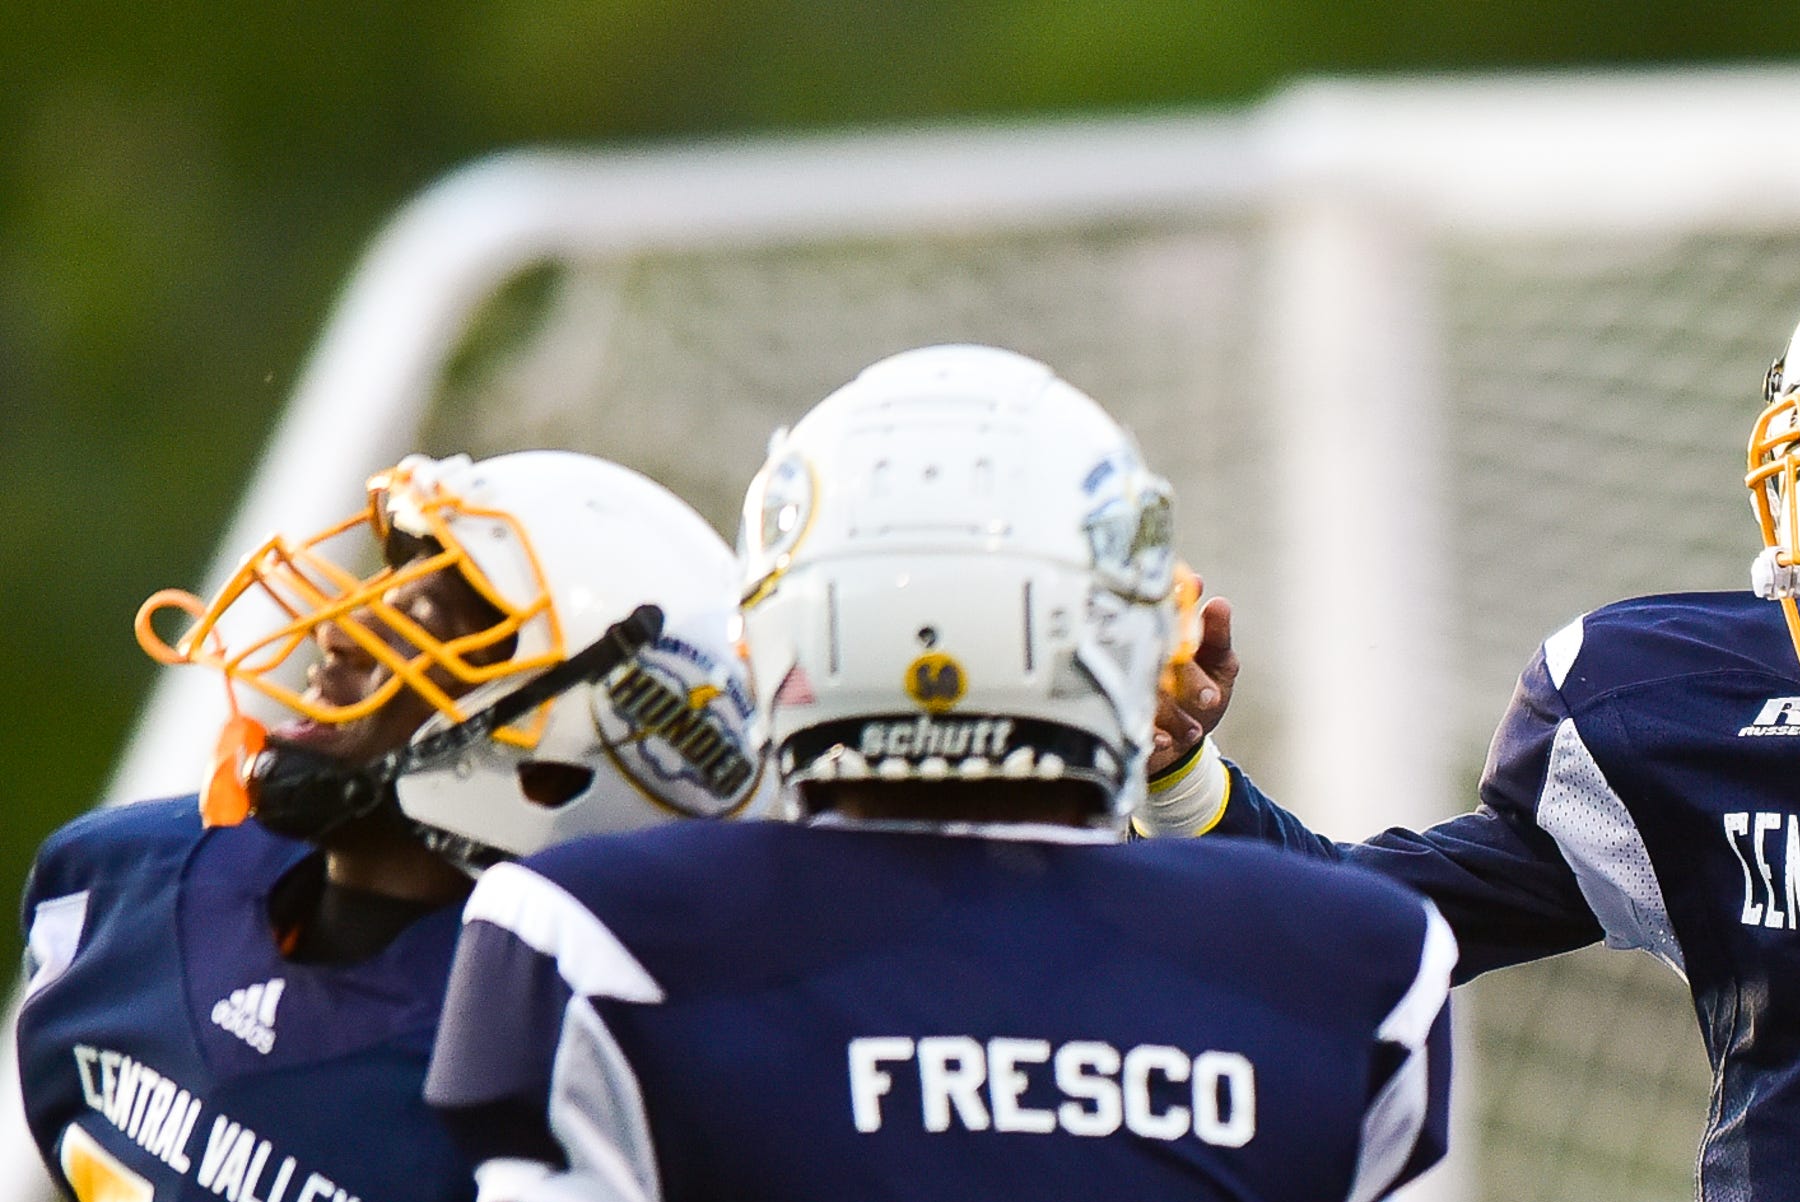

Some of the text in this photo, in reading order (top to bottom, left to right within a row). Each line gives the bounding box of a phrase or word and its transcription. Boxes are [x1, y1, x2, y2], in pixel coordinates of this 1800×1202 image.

[608, 666, 753, 800] HUNDER
[861, 715, 1014, 756] schutt
[73, 1044, 202, 1175] CENTRAL
[847, 1035, 1256, 1148] FRESCO
